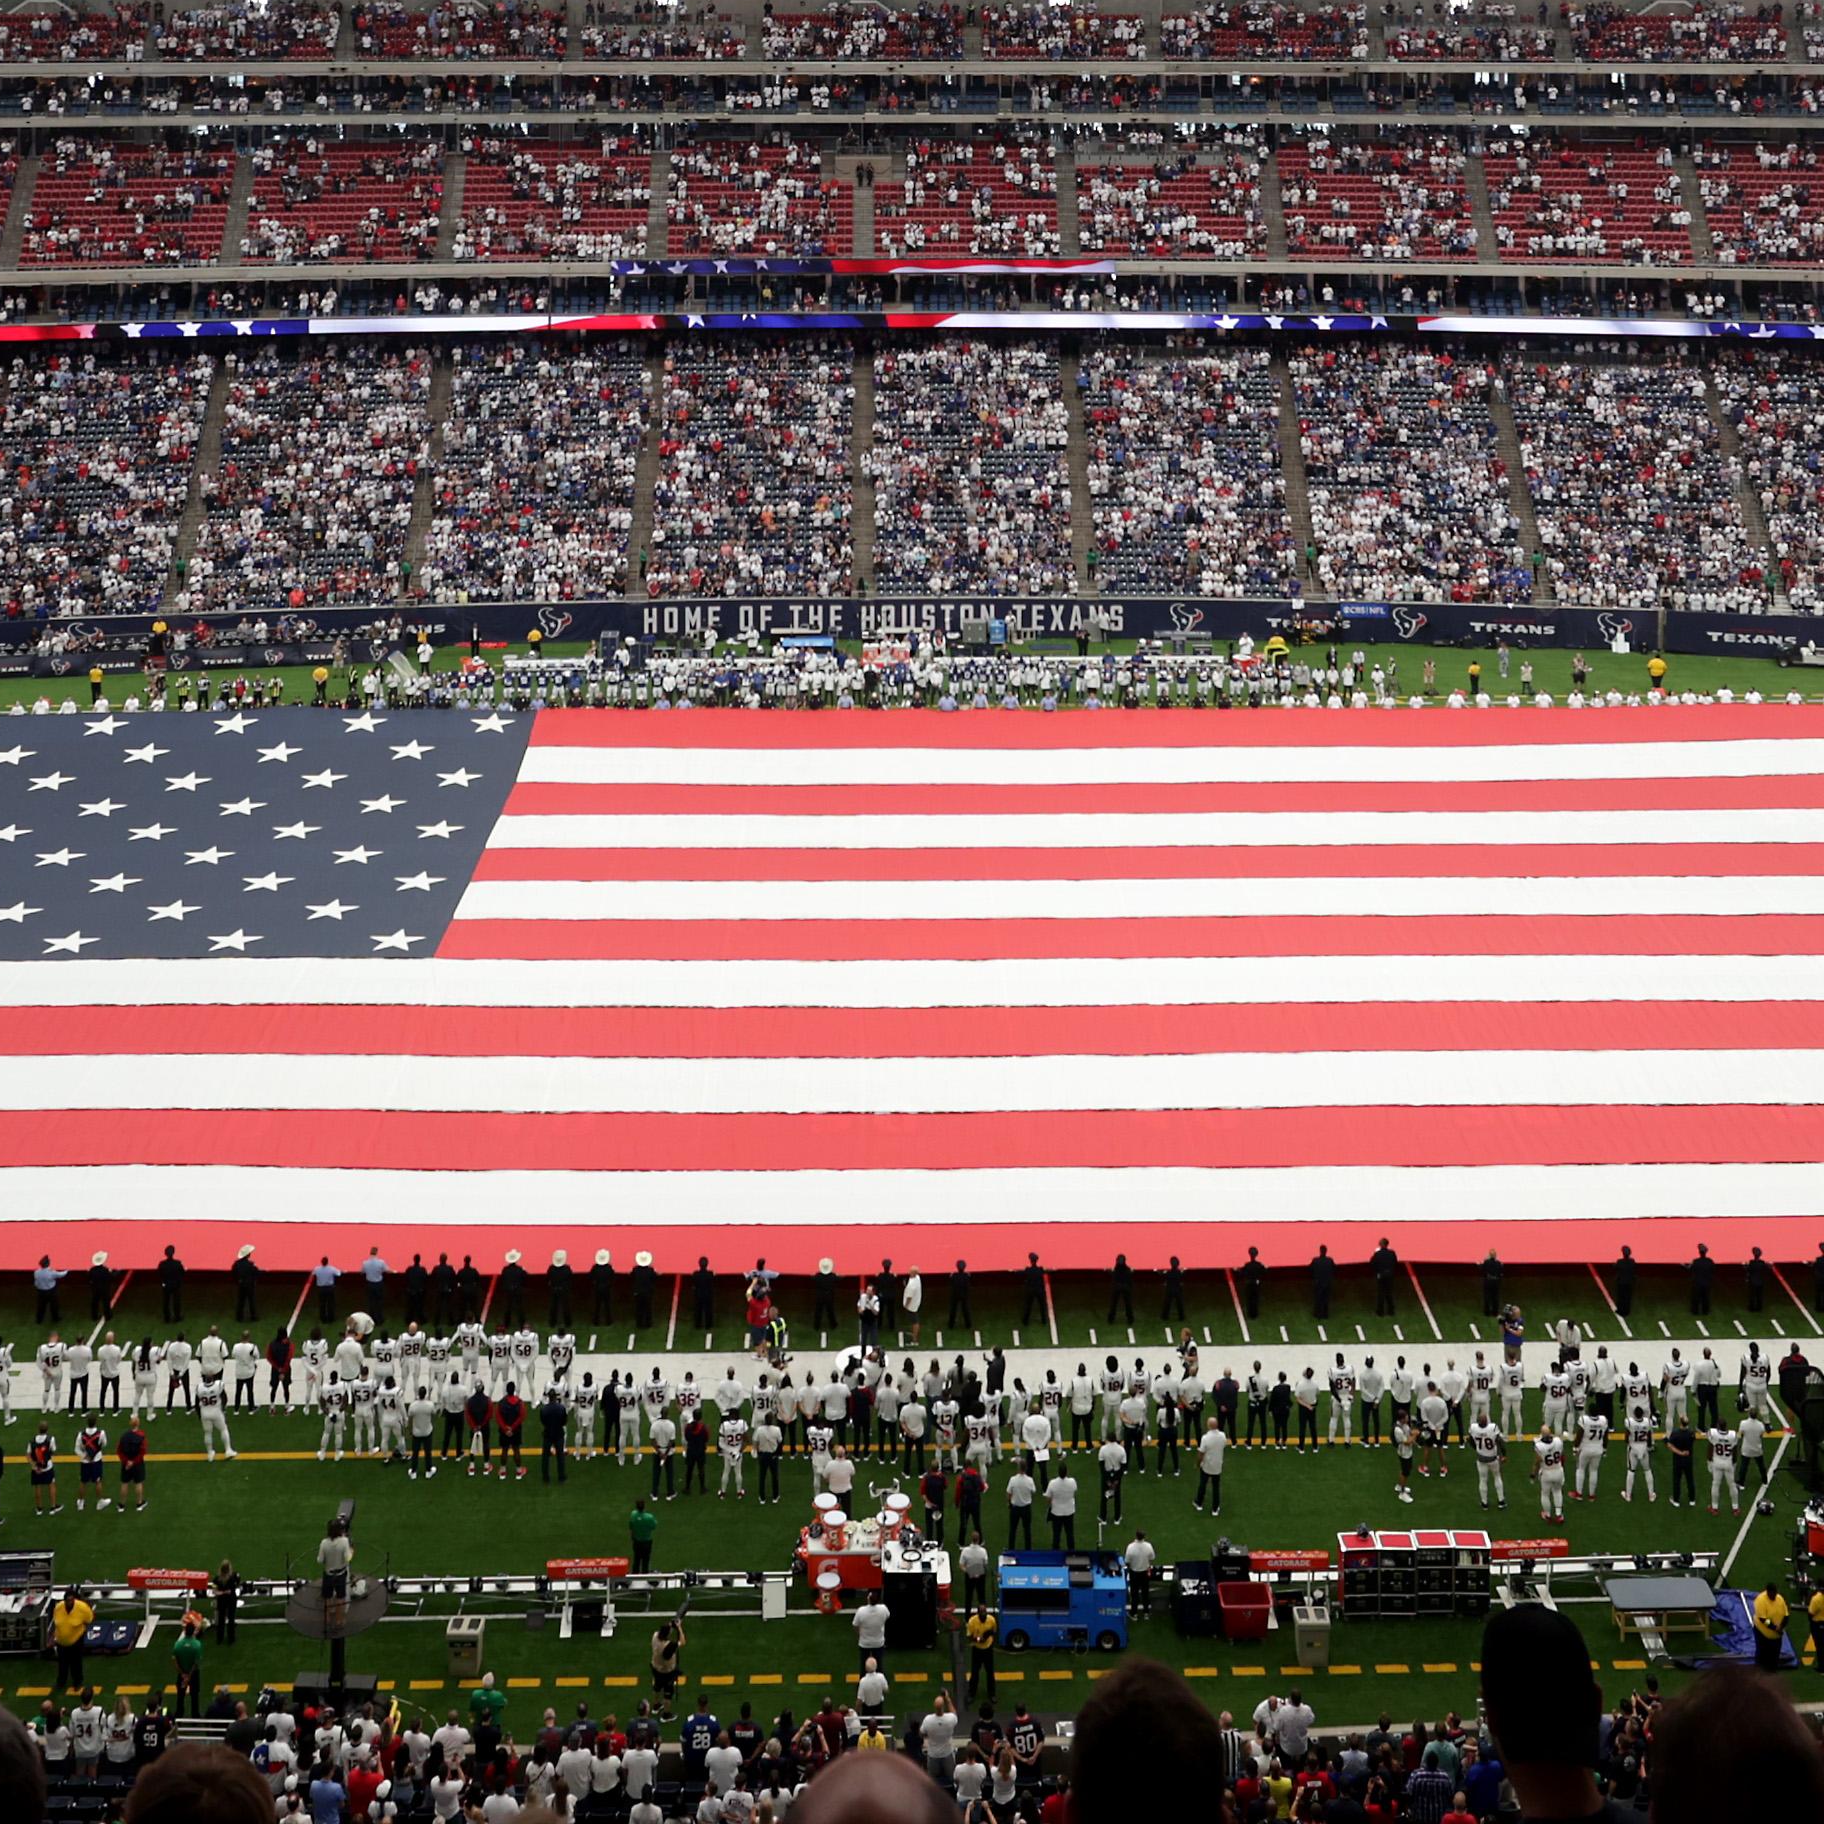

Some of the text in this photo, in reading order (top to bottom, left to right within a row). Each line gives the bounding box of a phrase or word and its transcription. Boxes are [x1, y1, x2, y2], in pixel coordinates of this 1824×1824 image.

[643, 604, 1125, 634] HOME OF THE HOUSTON TEXANS
[1706, 631, 1796, 645] TEXANS
[201, 657, 243, 665] TEXANS
[463, 1336, 476, 1347] 51
[405, 1344, 420, 1355] 28
[430, 1350, 446, 1360] 23
[516, 1345, 531, 1356] 58
[310, 1353, 318, 1365] 5
[376, 1352, 392, 1363] 50
[1750, 1367, 1766, 1377] 59
[1335, 1378, 1351, 1390] 83
[1477, 1378, 1488, 1389] 10
[1510, 1376, 1518, 1387] 6
[1576, 1374, 1584, 1385] 9
[1671, 1376, 1686, 1385] 67
[1551, 1386, 1566, 1397] 60
[1629, 1386, 1646, 1397] 64
[579, 1396, 594, 1407] 24
[648, 1392, 664, 1404] 45
[679, 1395, 694, 1406] 36
[757, 1398, 770, 1409] 31
[1046, 1392, 1061, 1404] 20
[970, 1428, 987, 1439] 34
[1589, 1430, 1603, 1441] 71
[1635, 1431, 1648, 1442] 12
[811, 1439, 827, 1451] 33
[1477, 1438, 1494, 1450] 78
[1716, 1444, 1731, 1456] 85
[1545, 1452, 1560, 1466] 68
[1508, 1548, 1551, 1556] GATORADE
[565, 1567, 609, 1575] GATORADE
[145, 1578, 188, 1586] GATORADE
[76, 1723, 92, 1737] 34
